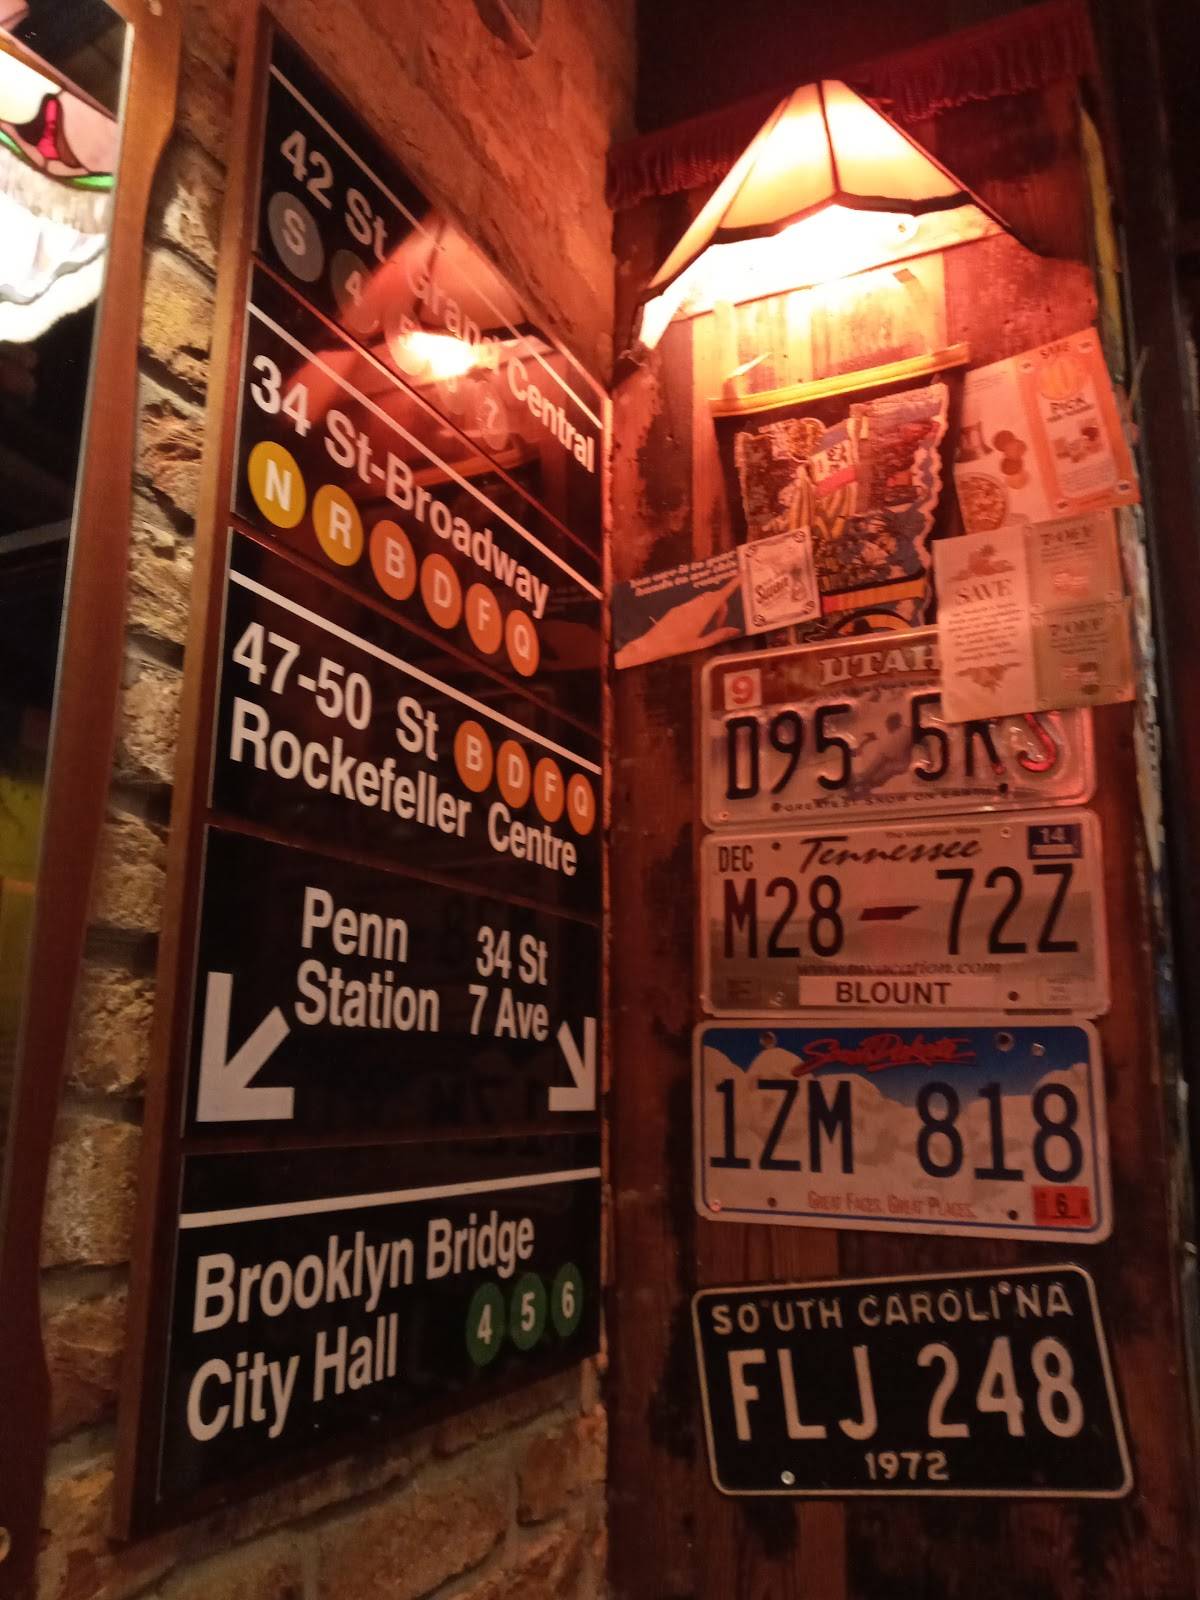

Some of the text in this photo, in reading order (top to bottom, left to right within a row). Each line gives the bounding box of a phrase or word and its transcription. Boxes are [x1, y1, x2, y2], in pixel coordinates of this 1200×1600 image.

[282, 208, 307, 256] S
[281, 131, 333, 209] 42
[345, 188, 387, 263] St
[507, 356, 595, 473] Central
[251, 355, 549, 619] 34 St-Broadway
[265, 459, 531, 660] N R B D F Q
[232, 621, 439, 761] 47-50 St
[729, 675, 755, 706] 9
[819, 643, 941, 687] UTAH
[229, 697, 576, 876] Rockefeller Centre
[464, 734, 589, 817] B D F Q
[717, 844, 755, 873] DEC
[799, 835, 984, 875] Tennessee
[301, 886, 409, 963] Penn
[476, 925, 549, 986] 34 St
[294, 958, 440, 1033] Station
[468, 983, 549, 1042] 7 Ave
[836, 981, 953, 1007] BLOUNT
[709, 1078, 1085, 1184] 1ZM 818
[192, 1210, 535, 1334] Brooklyn Bridge
[711, 1281, 1074, 1336] SOUTH CAROLINA
[477, 1281, 575, 1345] 4 5 6
[186, 1312, 399, 1442] City Hall
[727, 1335, 1085, 1442] FLJ 248
[863, 1449, 951, 1482] 1972
